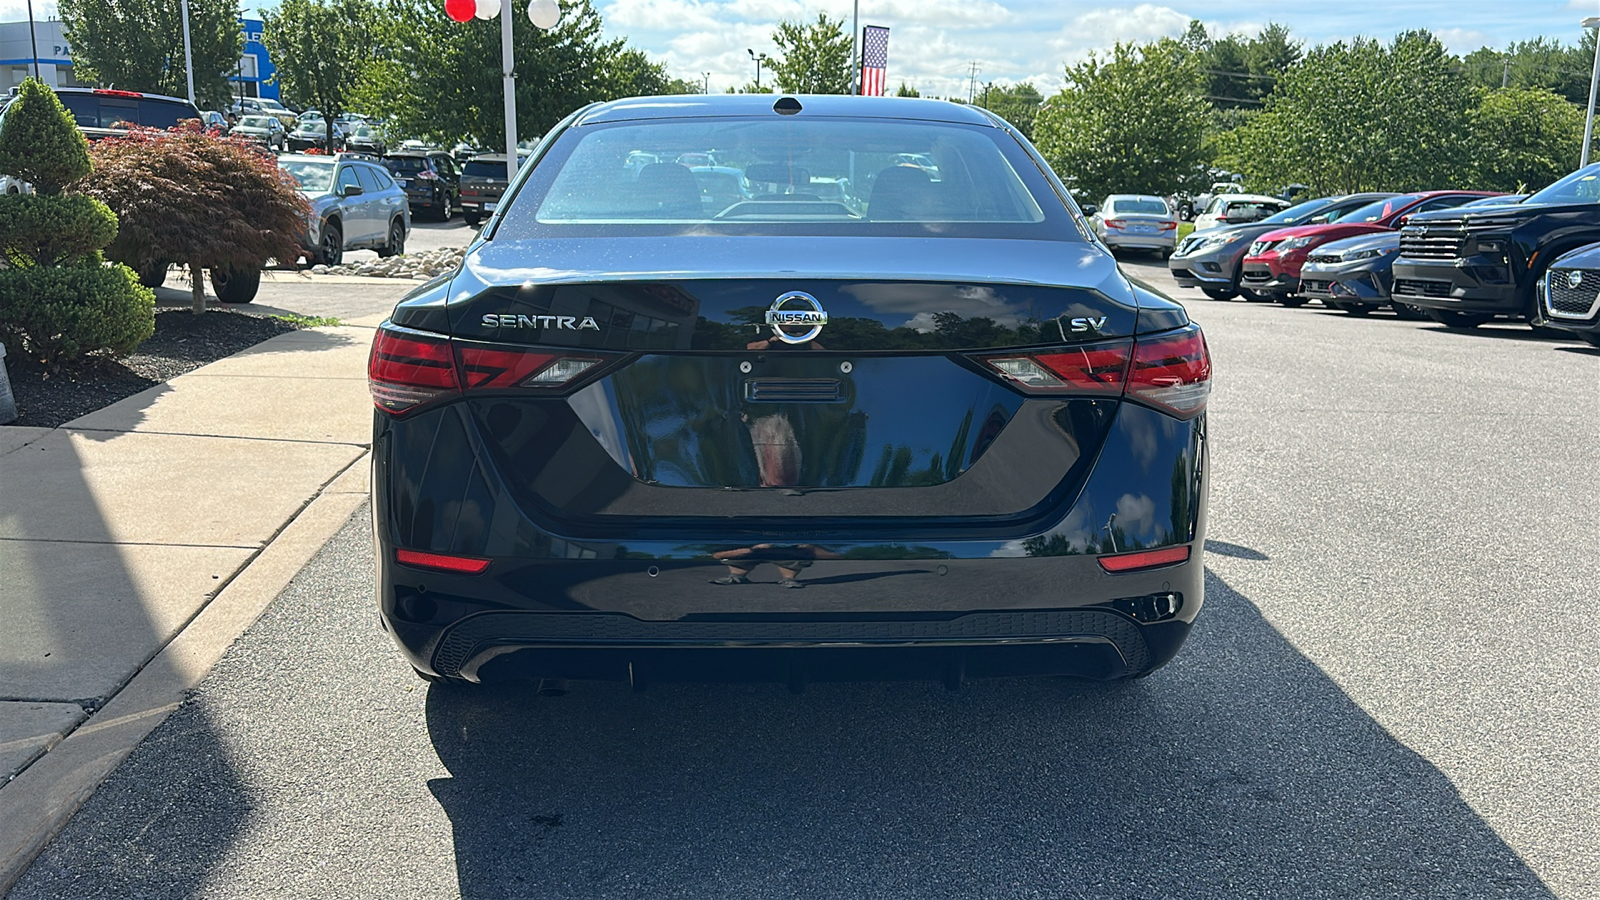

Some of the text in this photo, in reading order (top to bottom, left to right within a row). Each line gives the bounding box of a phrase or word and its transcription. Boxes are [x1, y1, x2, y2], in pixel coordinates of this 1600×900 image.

[481, 313, 600, 331] SENTRA
[772, 313, 821, 322] NISSAN
[1071, 316, 1107, 332] SV
